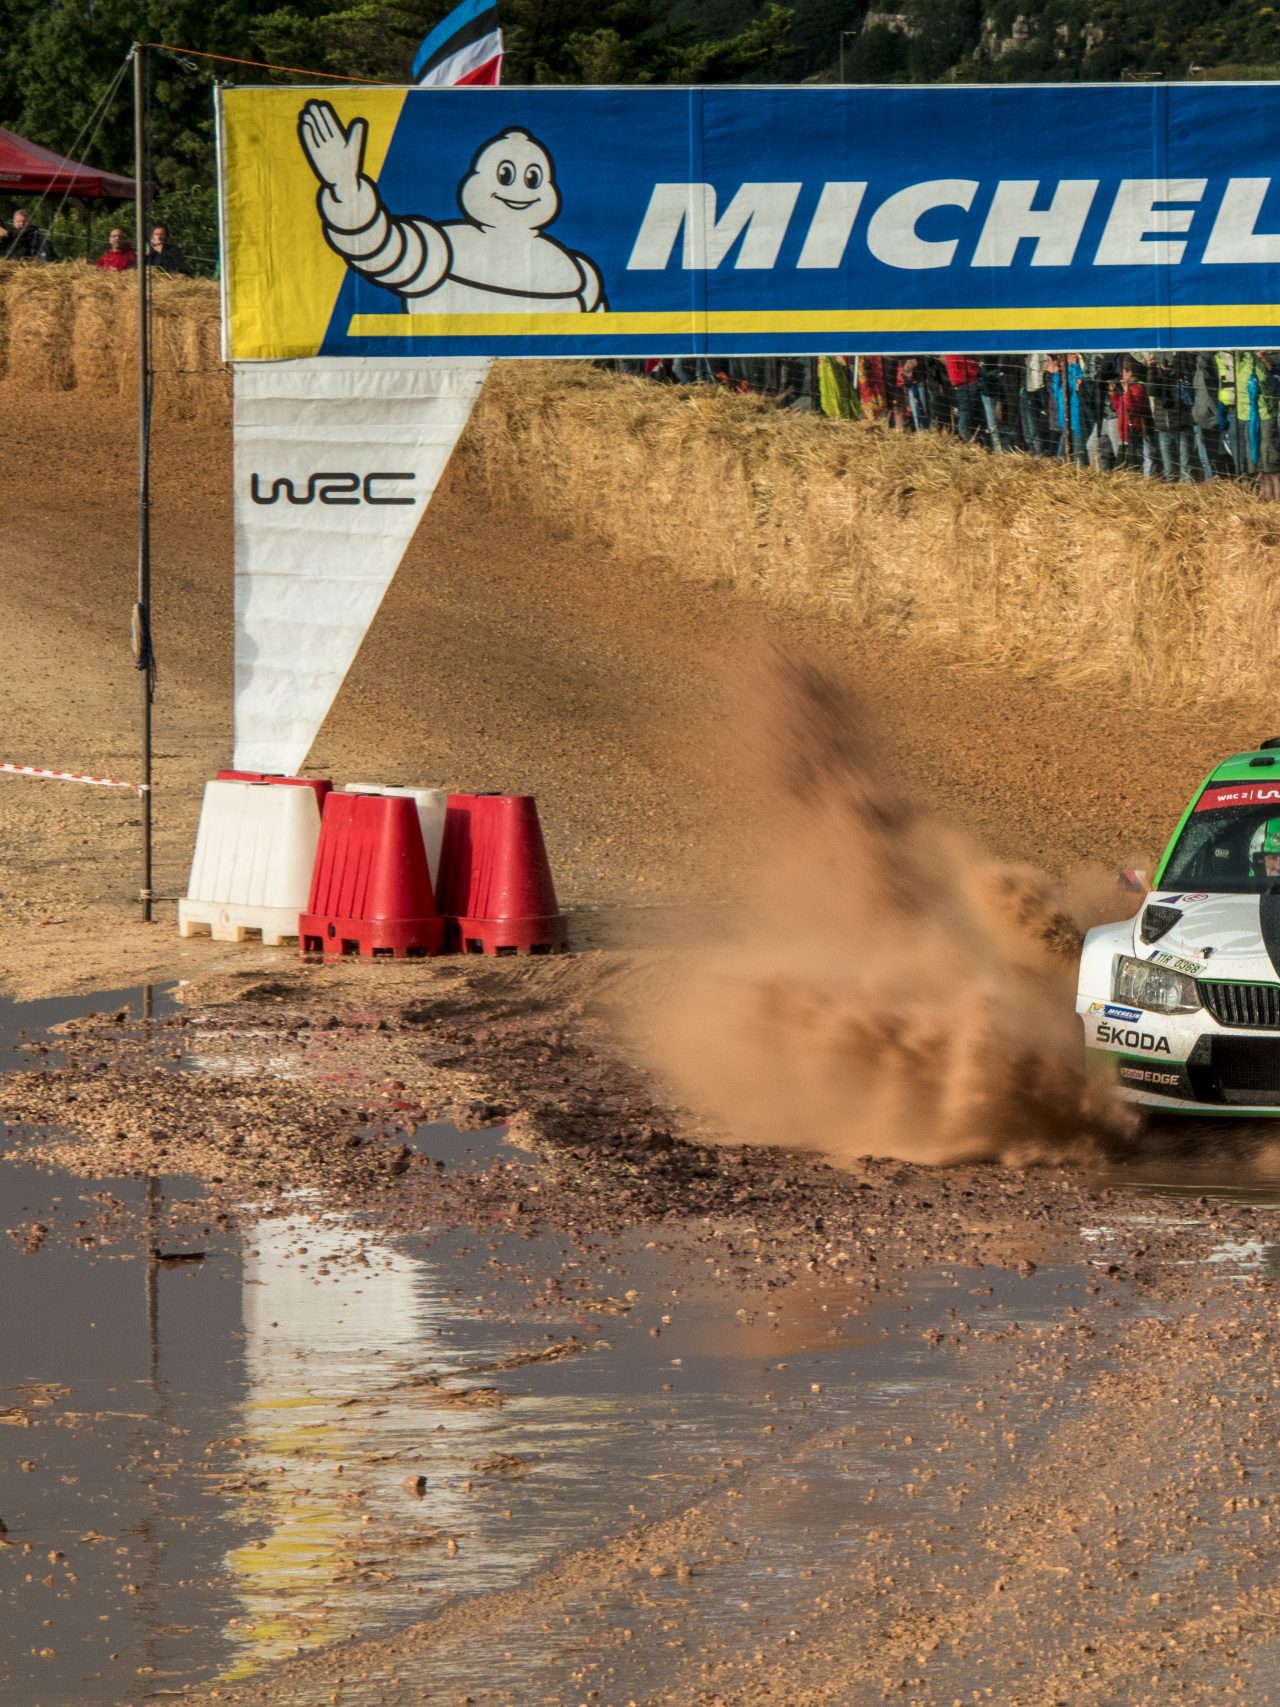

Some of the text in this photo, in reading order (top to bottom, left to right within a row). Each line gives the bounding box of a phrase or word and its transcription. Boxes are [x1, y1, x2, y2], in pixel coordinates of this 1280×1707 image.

[251, 472, 416, 505] WRC
[1217, 793, 1239, 801] WRC
[1174, 960, 1200, 974] 0368
[1107, 1008, 1141, 1019] MICHELIN
[1096, 1021, 1171, 1054] ŠKODA
[1144, 1071, 1180, 1085] EDGE
